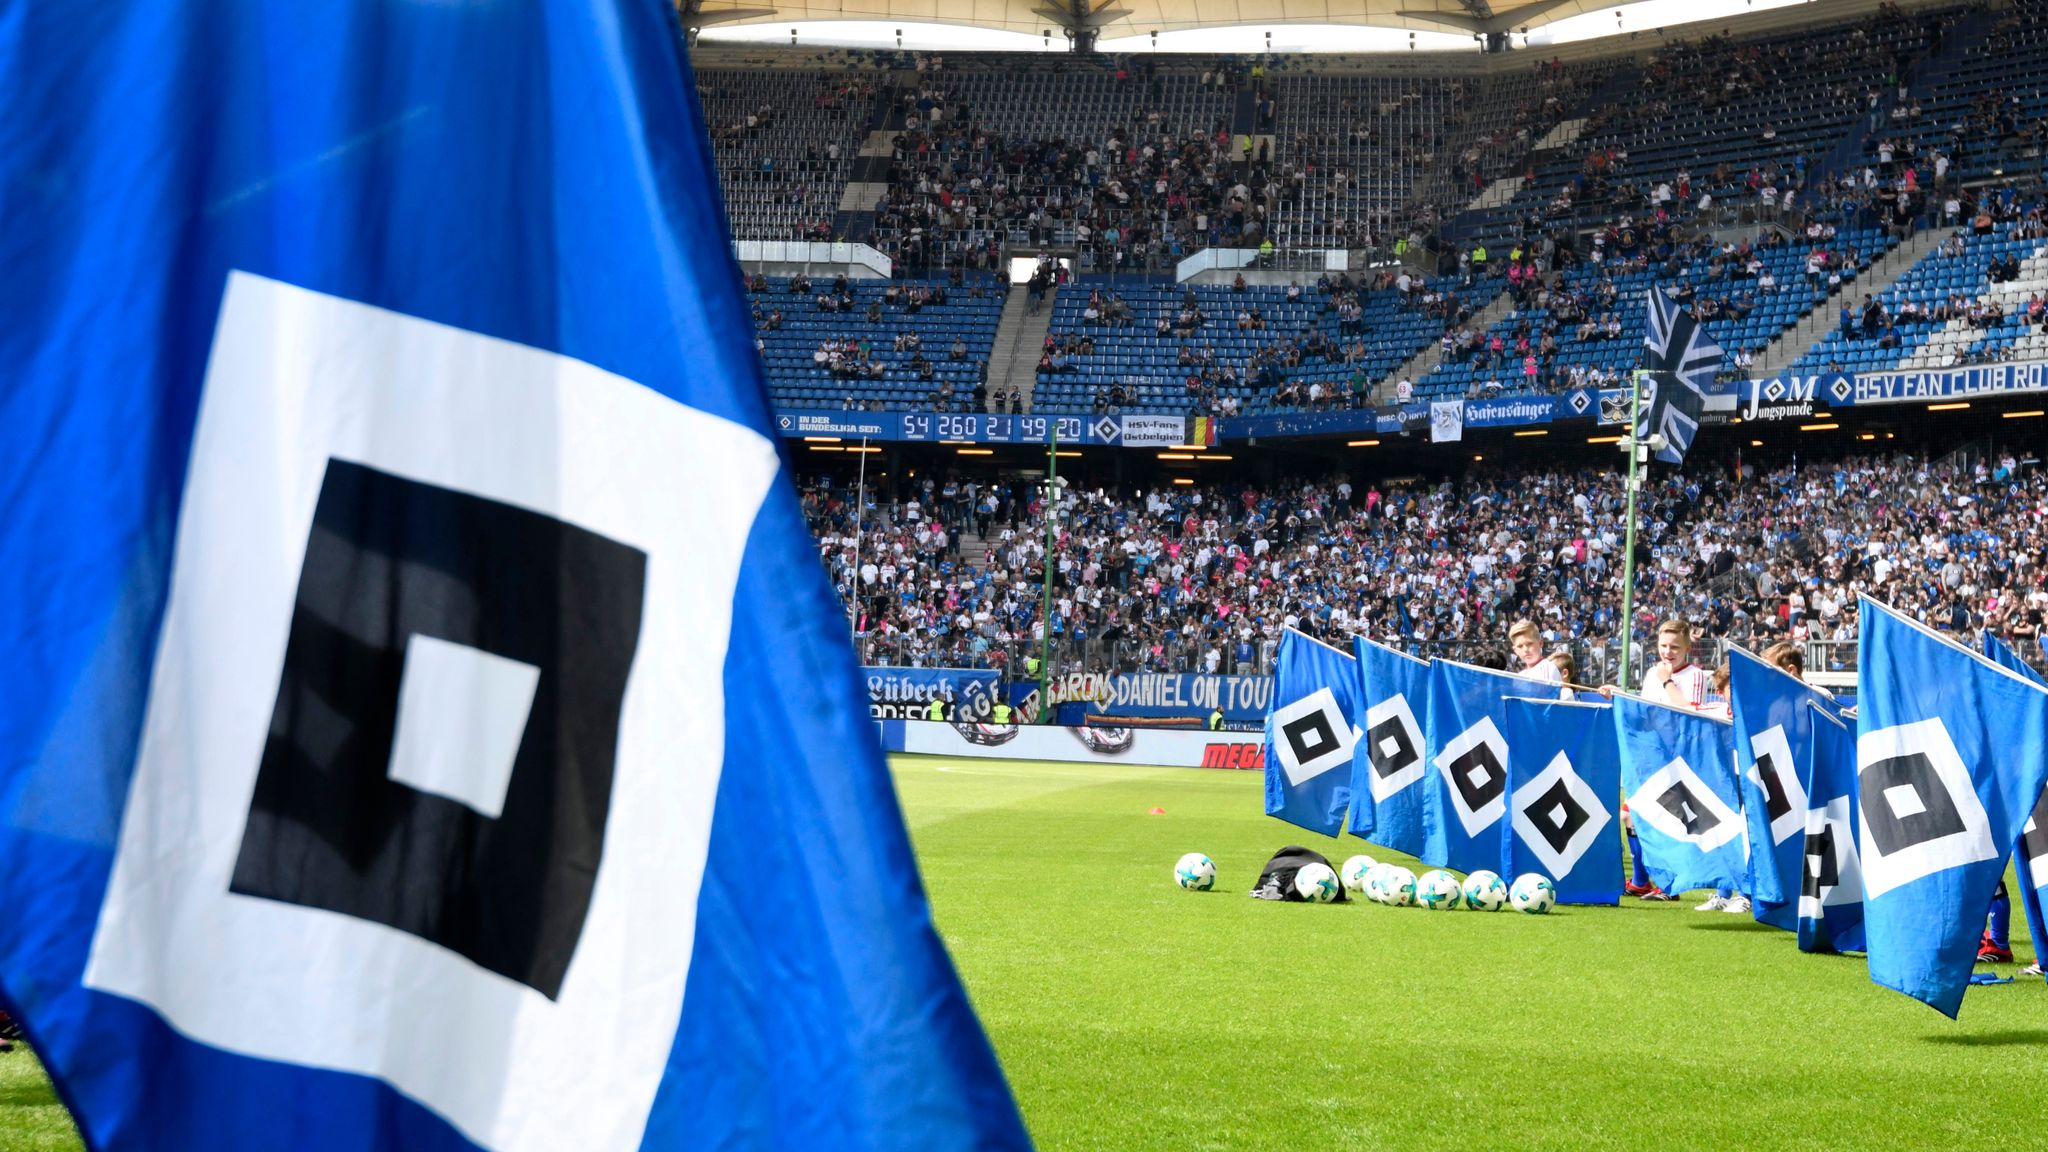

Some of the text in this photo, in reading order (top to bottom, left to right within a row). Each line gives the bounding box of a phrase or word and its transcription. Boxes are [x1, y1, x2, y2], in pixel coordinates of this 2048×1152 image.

[1854, 362, 2048, 400] HSV FAN CLUB RO
[799, 416, 830, 424] IN DER
[904, 415, 929, 434] 54
[938, 416, 977, 435] 260
[986, 417, 1011, 436] 21
[1022, 417, 1046, 437] 49
[1056, 417, 1081, 437] 20
[1128, 421, 1179, 429] HSV-Fans
[799, 424, 882, 433] BUNDESLIGA SEIT:
[1124, 433, 1183, 442] Ostbelgien
[867, 675, 954, 702] Lübeck
[1118, 674, 1188, 707] DANIEL
[1192, 676, 1220, 709] ON
[1227, 676, 1274, 711] TOU
